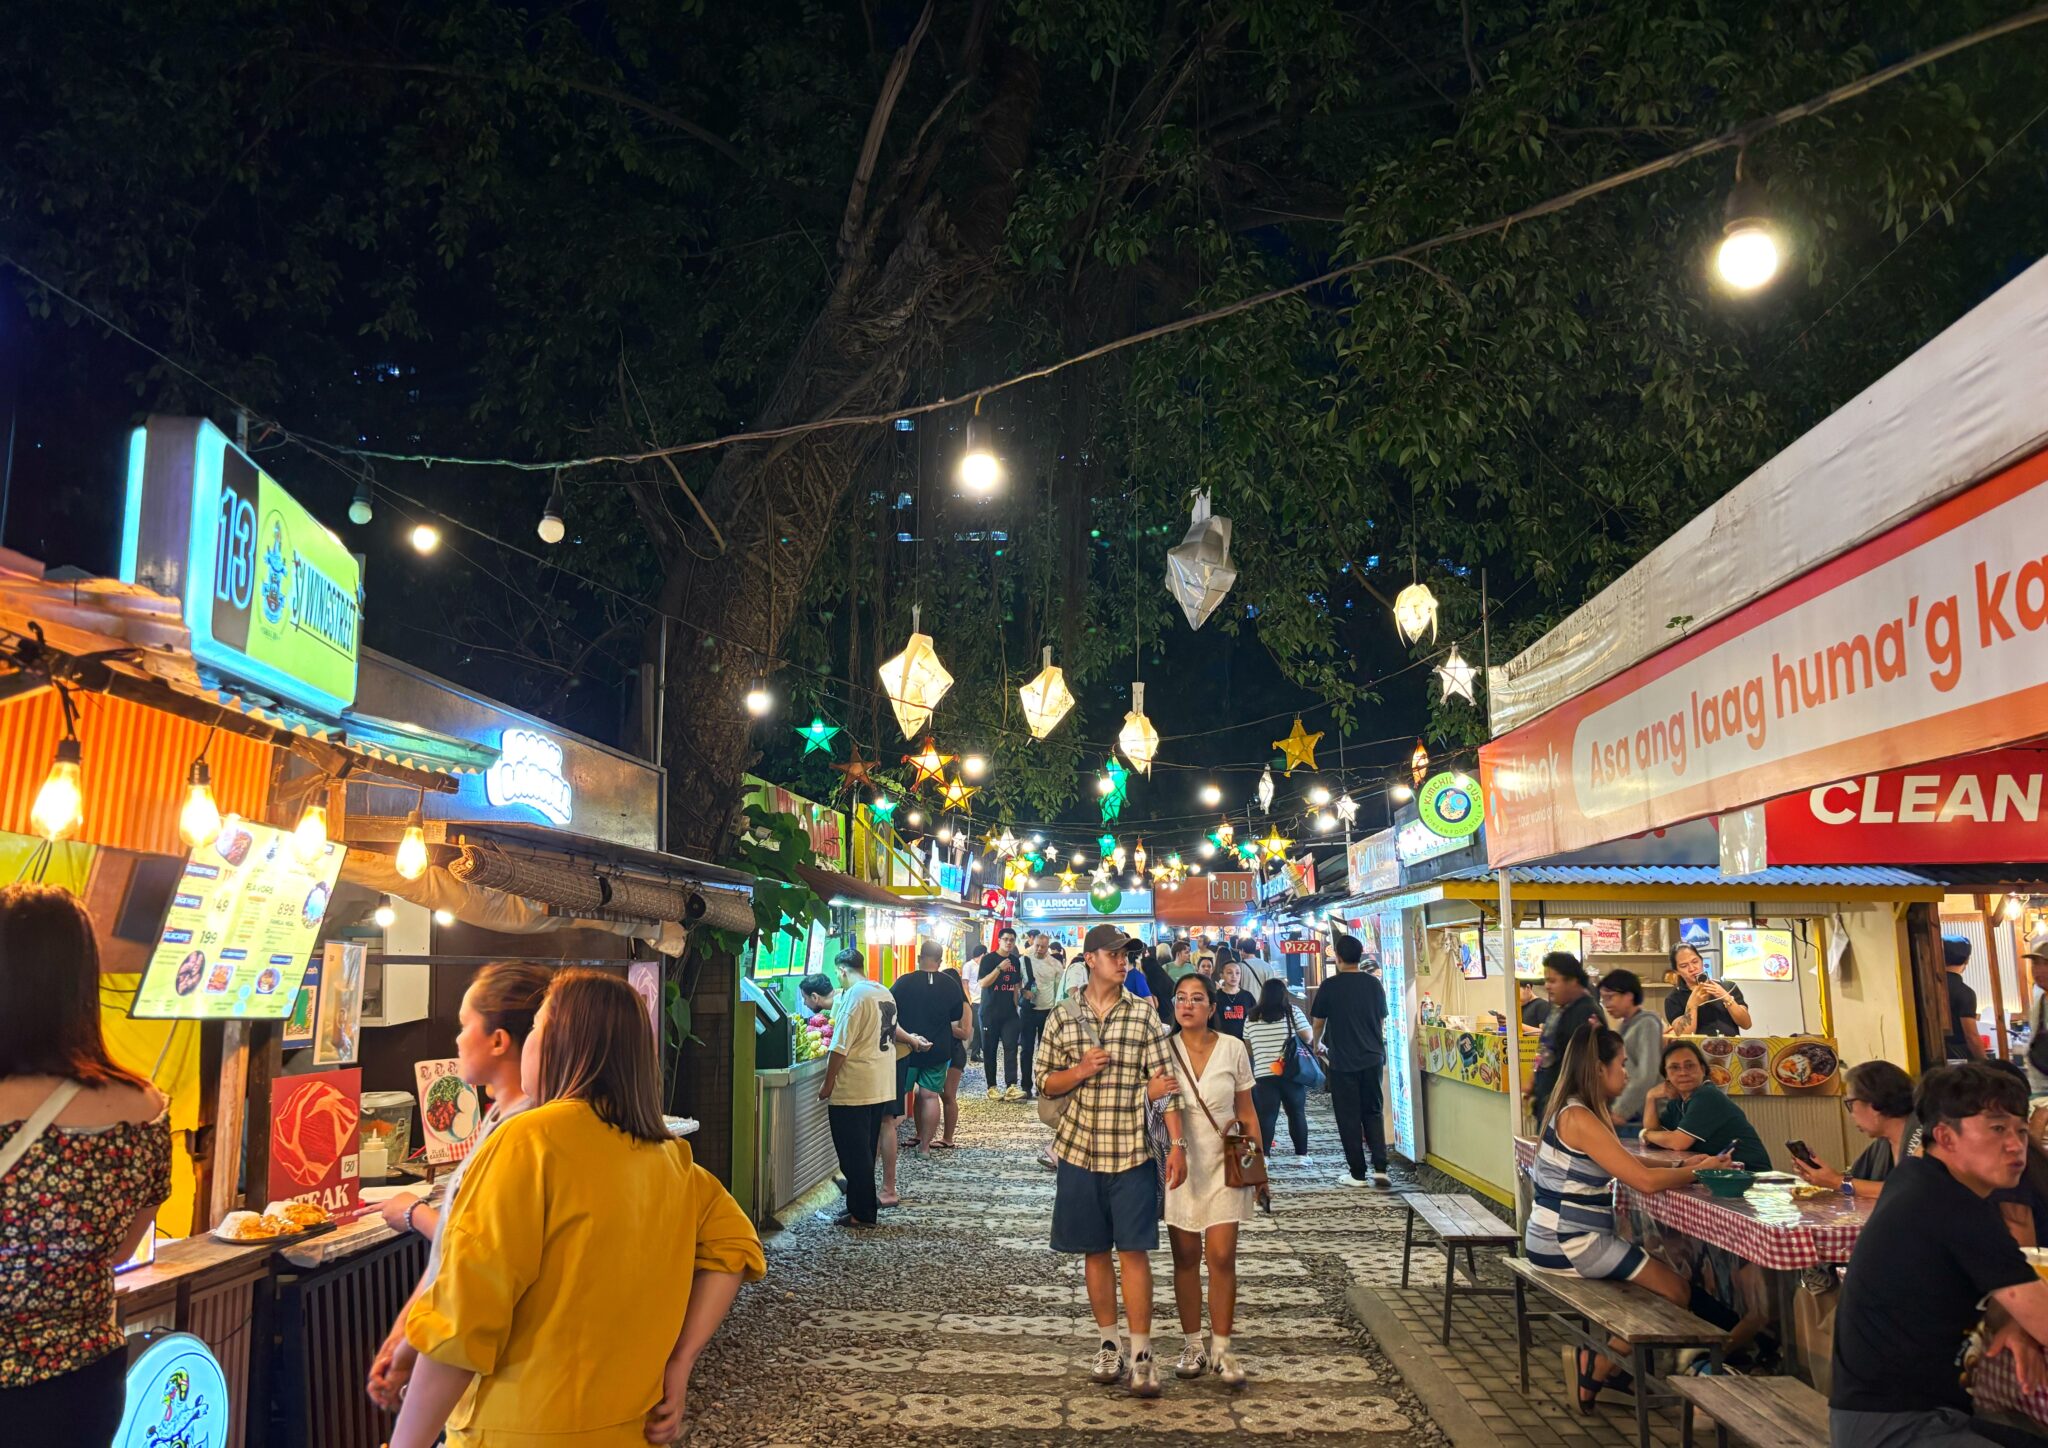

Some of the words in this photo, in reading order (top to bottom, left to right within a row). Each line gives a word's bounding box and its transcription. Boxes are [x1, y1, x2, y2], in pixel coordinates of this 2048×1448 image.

[214, 486, 256, 608] 13
[1591, 736, 1630, 789] Asa
[1635, 711, 1687, 776] ang
[1690, 676, 1766, 750] laag
[1772, 595, 1962, 719] huma'g
[1809, 774, 2043, 825] CLEAN
[277, 902, 295, 916] 899
[1037, 898, 1087, 908] MARIGOLD
[200, 930, 218, 944] 199
